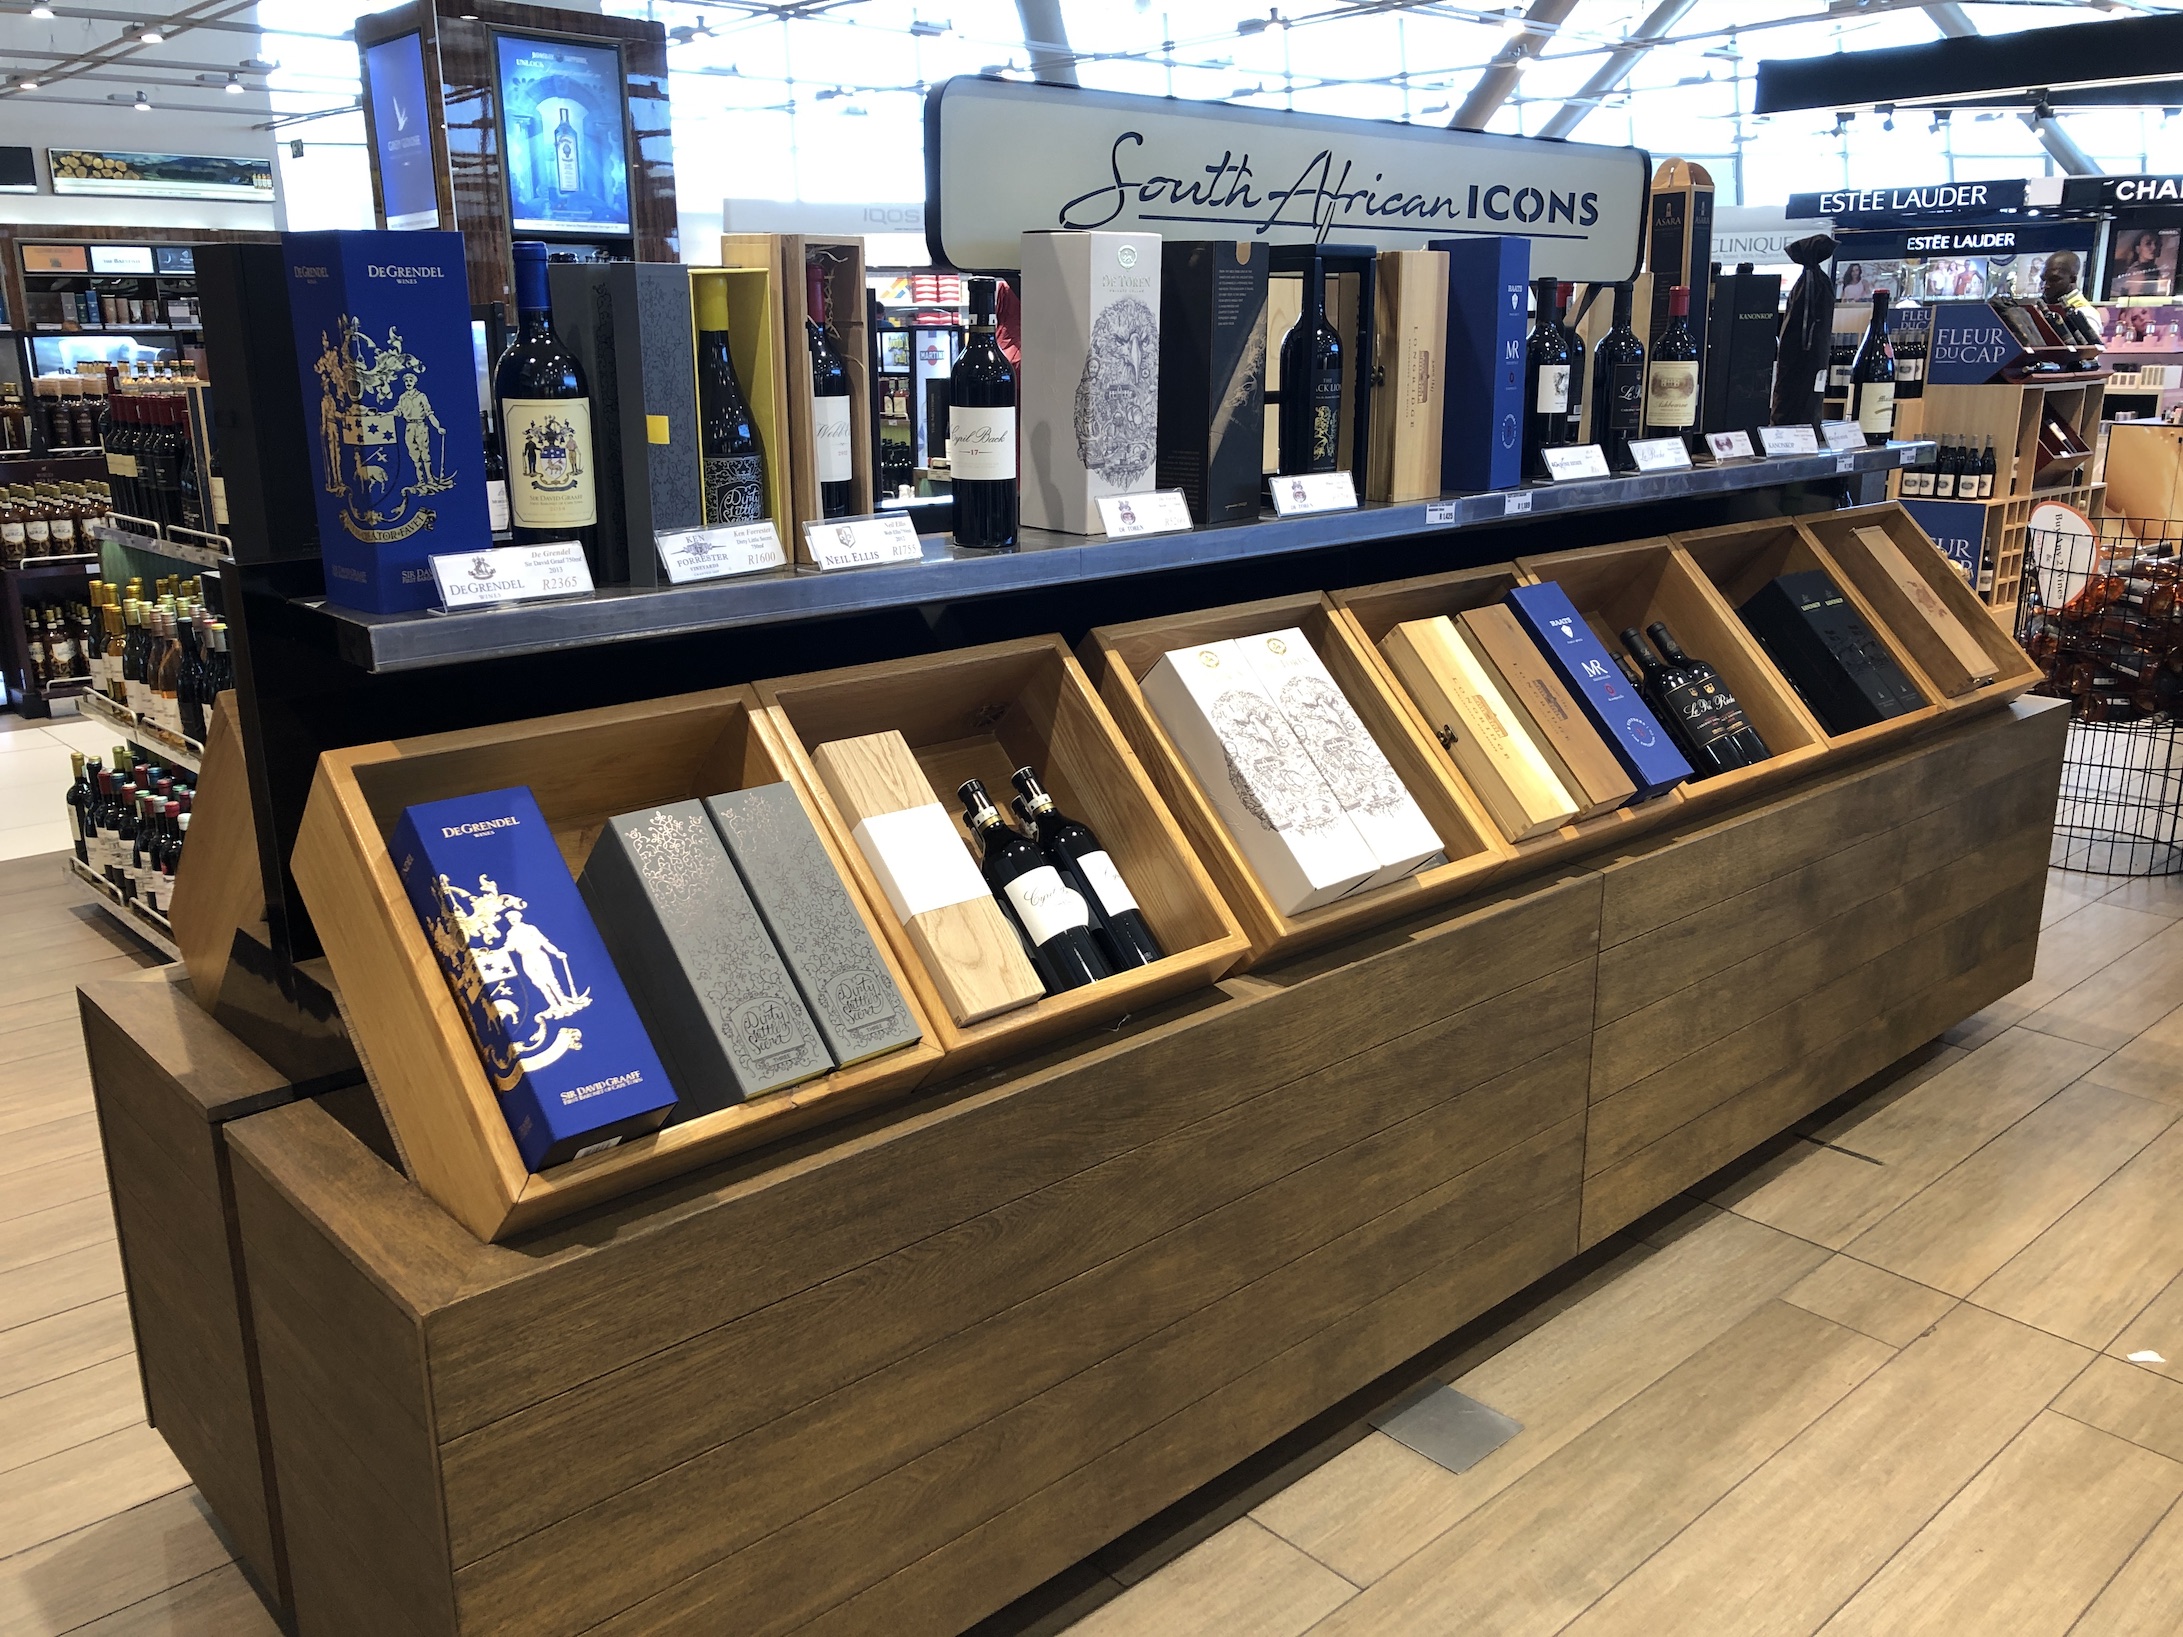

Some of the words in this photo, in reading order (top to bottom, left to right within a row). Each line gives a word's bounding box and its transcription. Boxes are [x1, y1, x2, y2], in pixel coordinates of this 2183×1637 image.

[1059, 131, 1262, 229] South
[1256, 150, 1460, 243] African
[1467, 184, 1599, 227] ICONS
[2116, 179, 2183, 201] CHA
[1892, 185, 1987, 209] LAUDER
[864, 208, 920, 225] IQOS
[1655, 217, 1682, 226] ASARA
[1953, 233, 2015, 249] LAUDER
[1119, 275, 1151, 288] TOREN
[1936, 328, 2006, 346] FLEUR
[972, 425, 1008, 443] Back
[685, 534, 705, 543] KEN
[542, 548, 571, 557] Grendel
[892, 544, 917, 556] R1755
[676, 553, 729, 567] FORRESTER
[748, 551, 776, 565] R1600
[825, 554, 851, 566] NEIL
[851, 551, 880, 563] ELLIS
[402, 570, 415, 579] SIR
[690, 563, 719, 571] VINEYARDS
[542, 576, 577, 590] R2365
[1549, 616, 1573, 627] RAATS
[1581, 659, 1609, 678] MR
[473, 830, 496, 838] WINES
[838, 976, 879, 1002] Dirty
[744, 1004, 786, 1031] Dirty
[843, 1005, 874, 1025] Secret
[749, 1034, 782, 1055] Secret
[773, 1053, 791, 1061] THREE
[560, 1090, 577, 1099] SIR
[576, 1081, 606, 1096] DAVID
[605, 1070, 641, 1087] GRAAFF
